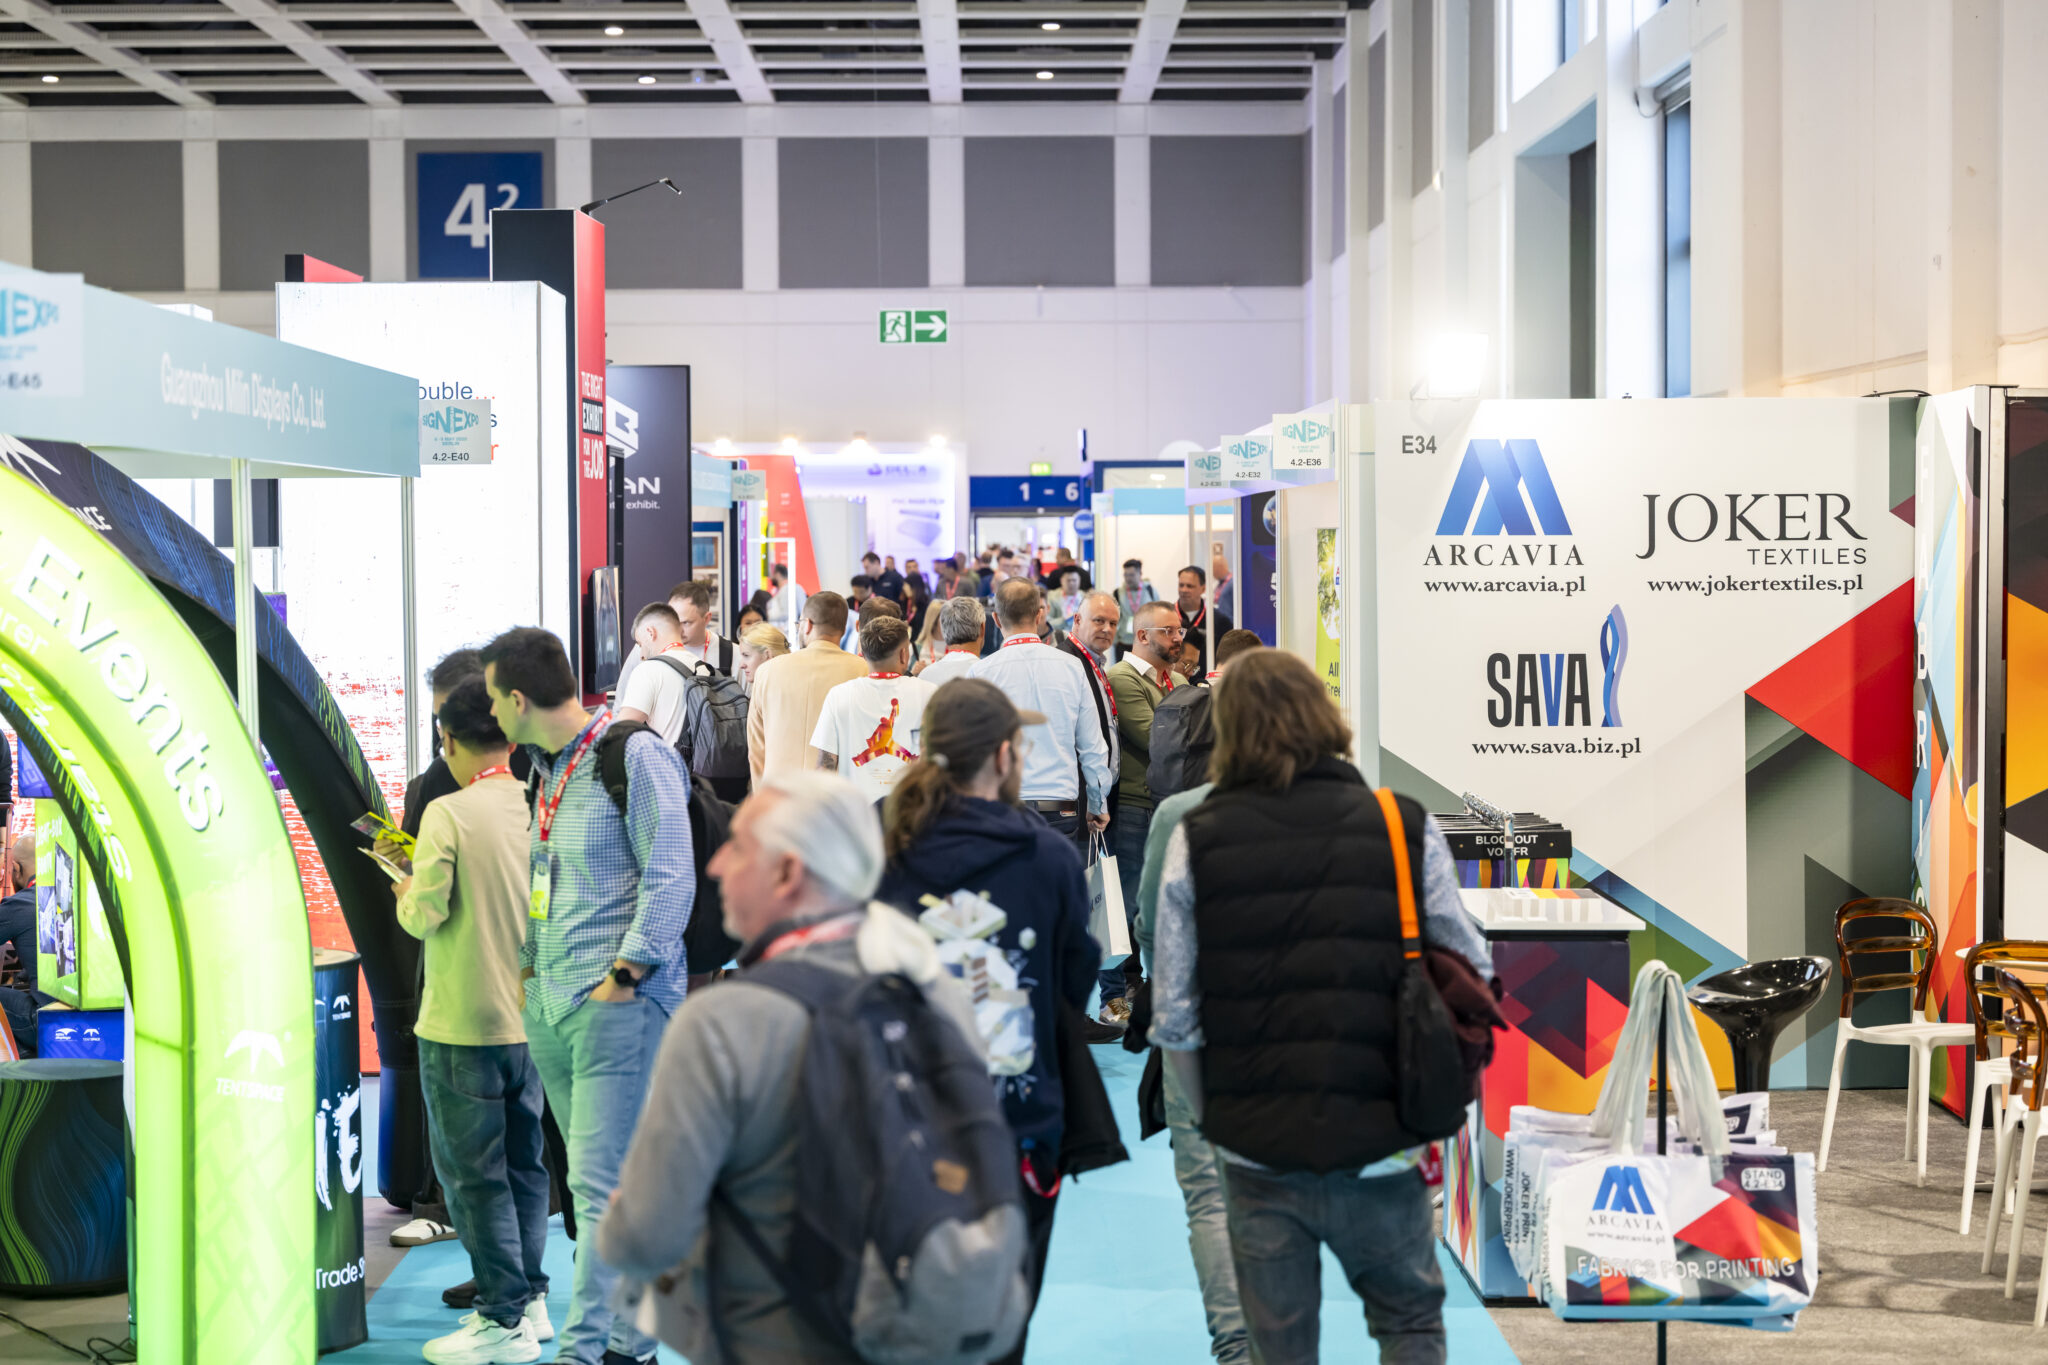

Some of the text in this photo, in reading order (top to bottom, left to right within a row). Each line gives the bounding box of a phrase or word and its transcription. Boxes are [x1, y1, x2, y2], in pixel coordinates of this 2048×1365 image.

[160, 351, 224, 421] Guangzhou
[251, 372, 291, 433] Displays
[1402, 435, 1438, 455] E34
[432, 452, 470, 462] 4.2-E40
[591, 439, 604, 480] JOB
[1290, 459, 1322, 467] 4.2-E36
[1235, 471, 1262, 479] 4.2-E32
[1019, 482, 1030, 501] 1
[1065, 482, 1079, 502] 6
[625, 500, 661, 510] exhibit.
[1636, 493, 1868, 560] JOKER
[1423, 543, 1585, 567] ARCAVIA
[1747, 548, 1867, 565] TEXTILES
[1424, 575, 1586, 597] www.arcavia.pl
[1647, 574, 1864, 597] www.jokertextiles.pl
[1487, 653, 1592, 728] SAVA
[1472, 737, 1642, 759] www.sava.biz.pl
[1475, 834, 1539, 846] BLOCOUT
[215, 1077, 286, 1102] TENTSPACE
[1744, 1169, 1782, 1180] STAND
[1586, 1213, 1664, 1232] ARCAVIA
[1577, 1256, 1796, 1280] FABRICS FOR PRINTING
